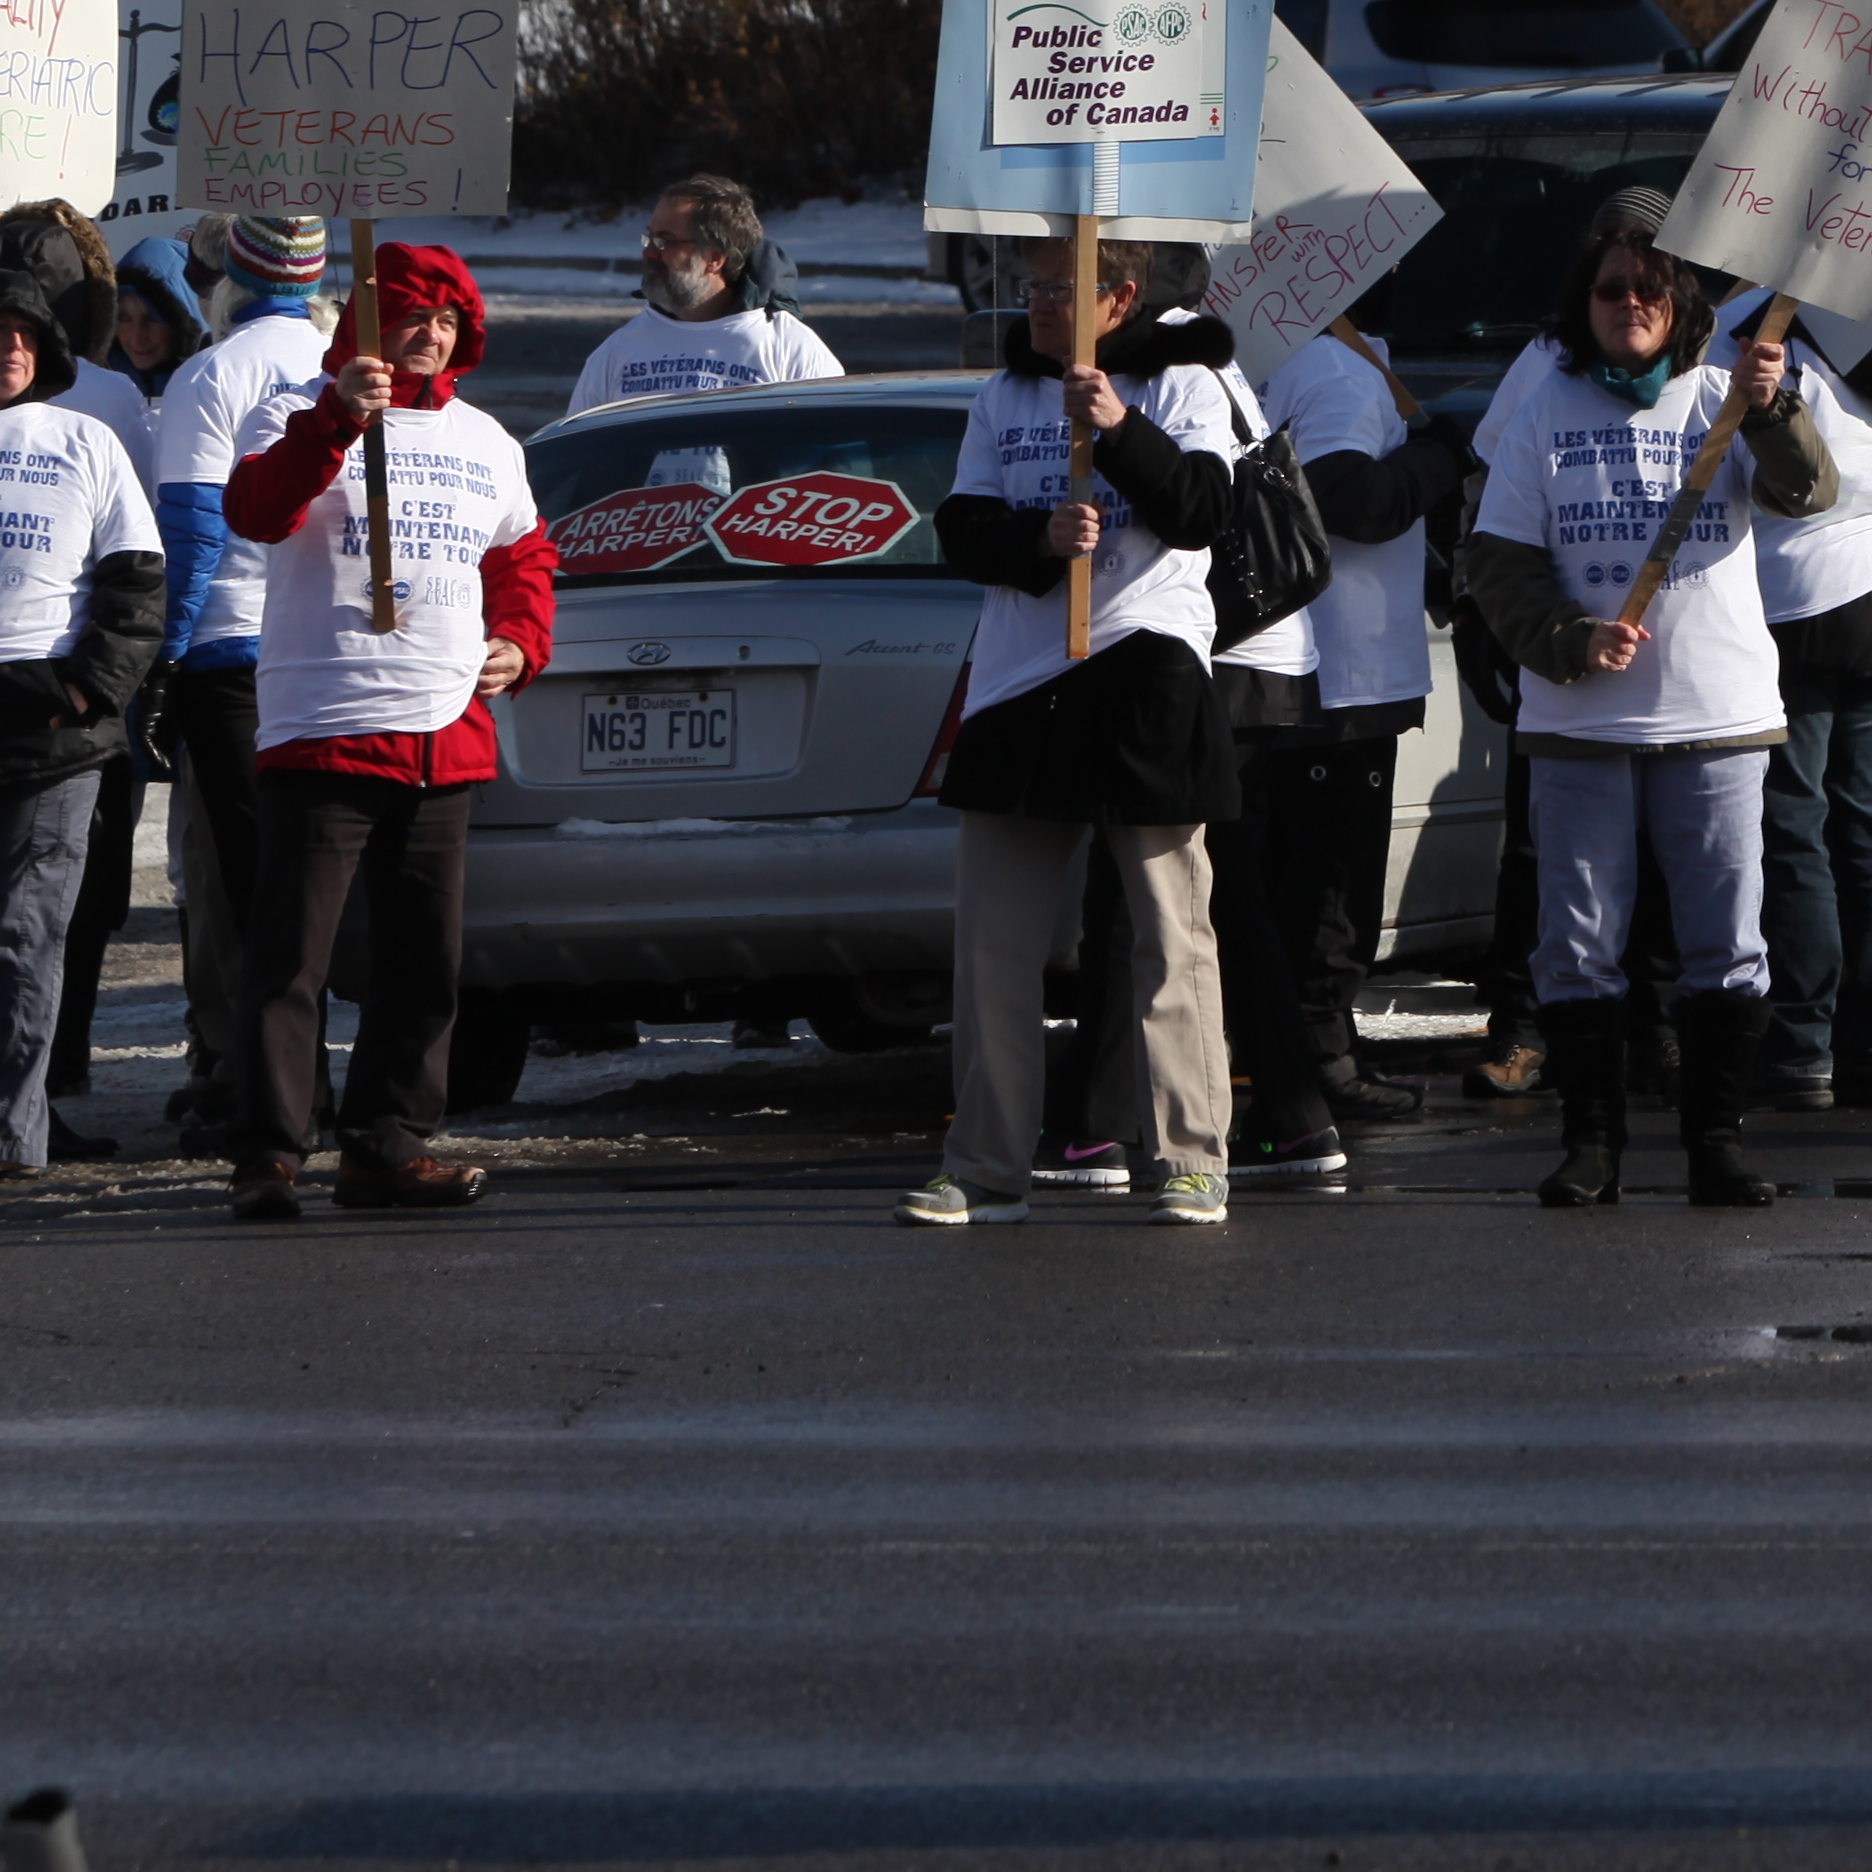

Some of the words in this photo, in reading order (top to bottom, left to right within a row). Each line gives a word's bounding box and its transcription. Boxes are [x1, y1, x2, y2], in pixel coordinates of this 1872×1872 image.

[1120, 9, 1148, 39] PSAC
[1157, 7, 1186, 37] AFPC
[1012, 25, 1104, 49] Public
[199, 8, 504, 106] HARPER
[1048, 52, 1155, 74] Service
[1009, 78, 1126, 101] Alliance
[1046, 106, 1077, 126] of
[1086, 101, 1189, 124] Canada
[195, 105, 455, 147] VETERANS
[205, 178, 427, 216] EMPLOYEES
[1714, 162, 1775, 216] The
[651, 352, 726, 377] VÉTÉRANS
[730, 364, 760, 381] ONT
[621, 376, 682, 394] COMBATTU
[997, 427, 1024, 447] LES
[1554, 431, 1587, 449] LES
[1592, 423, 1684, 448] VÉTÉRANS
[27, 454, 60, 470] ONT
[1556, 447, 1637, 468] COMBATTU
[19, 469, 59, 486] NOUS
[466, 460, 493, 481] ONT
[429, 471, 464, 490] POUR
[466, 477, 497, 500] NOUS
[1612, 479, 1672, 498] C'EST
[401, 500, 456, 520] C'EST
[561, 496, 720, 541] ARRÊTONS
[753, 487, 895, 531] STOP
[721, 513, 875, 553] HARPER!
[1560, 522, 1647, 545] NOTRE
[845, 639, 930, 656] Accent
[933, 642, 956, 655] GS
[641, 697, 691, 709] Québec
[587, 712, 647, 752] N63
[668, 709, 726, 749] FDC
[631, 758, 647, 766] me
[650, 756, 698, 765] souviens
